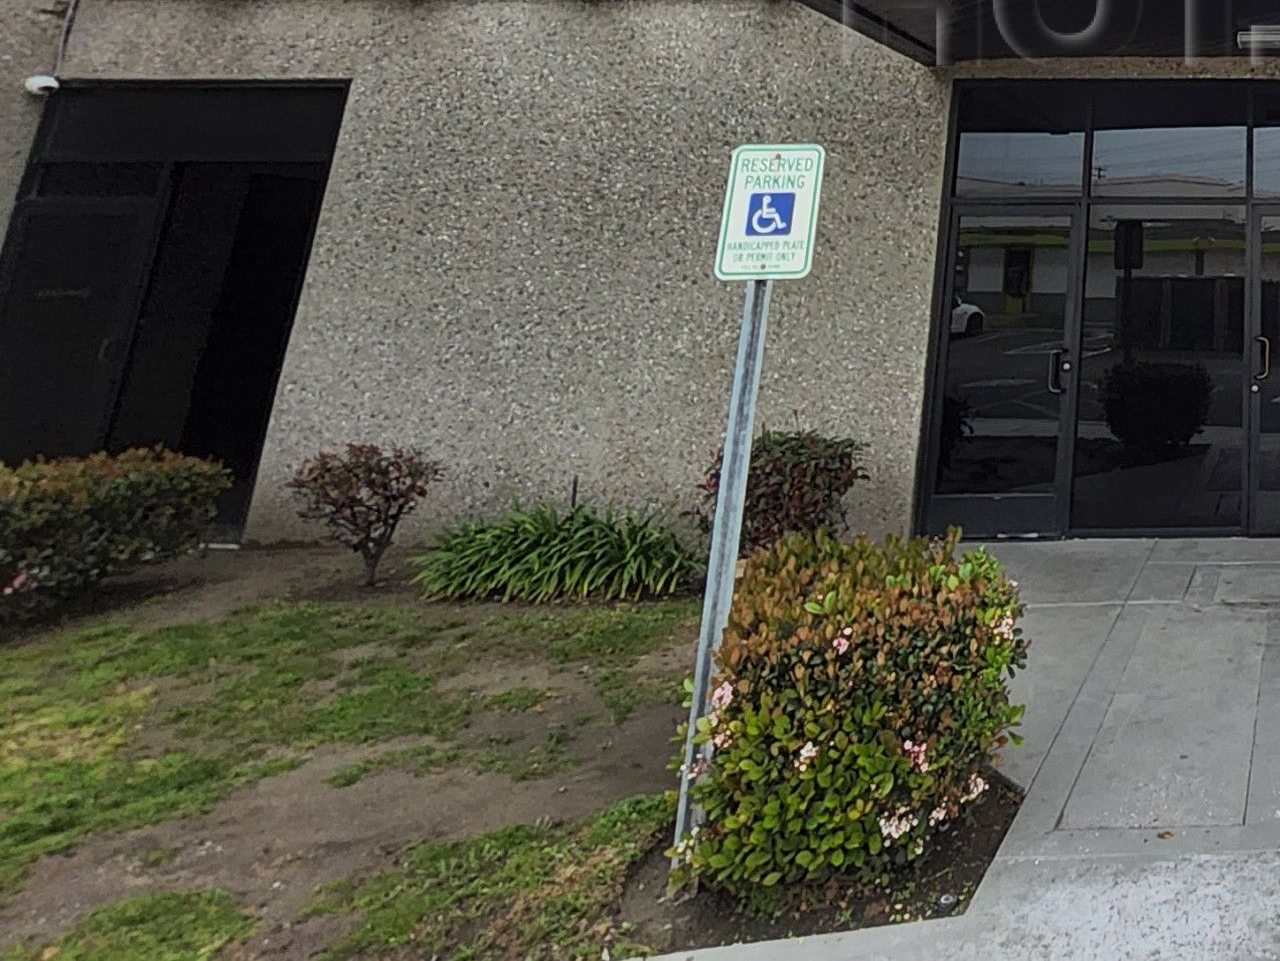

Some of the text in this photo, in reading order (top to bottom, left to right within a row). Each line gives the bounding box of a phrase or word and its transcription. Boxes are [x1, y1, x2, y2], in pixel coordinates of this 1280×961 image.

[741, 157, 814, 173] RESERVED
[744, 174, 806, 190] PARKING
[727, 240, 805, 251] HANDICAPPED PLATE
[733, 251, 797, 263] OR PERMIT ONLY
